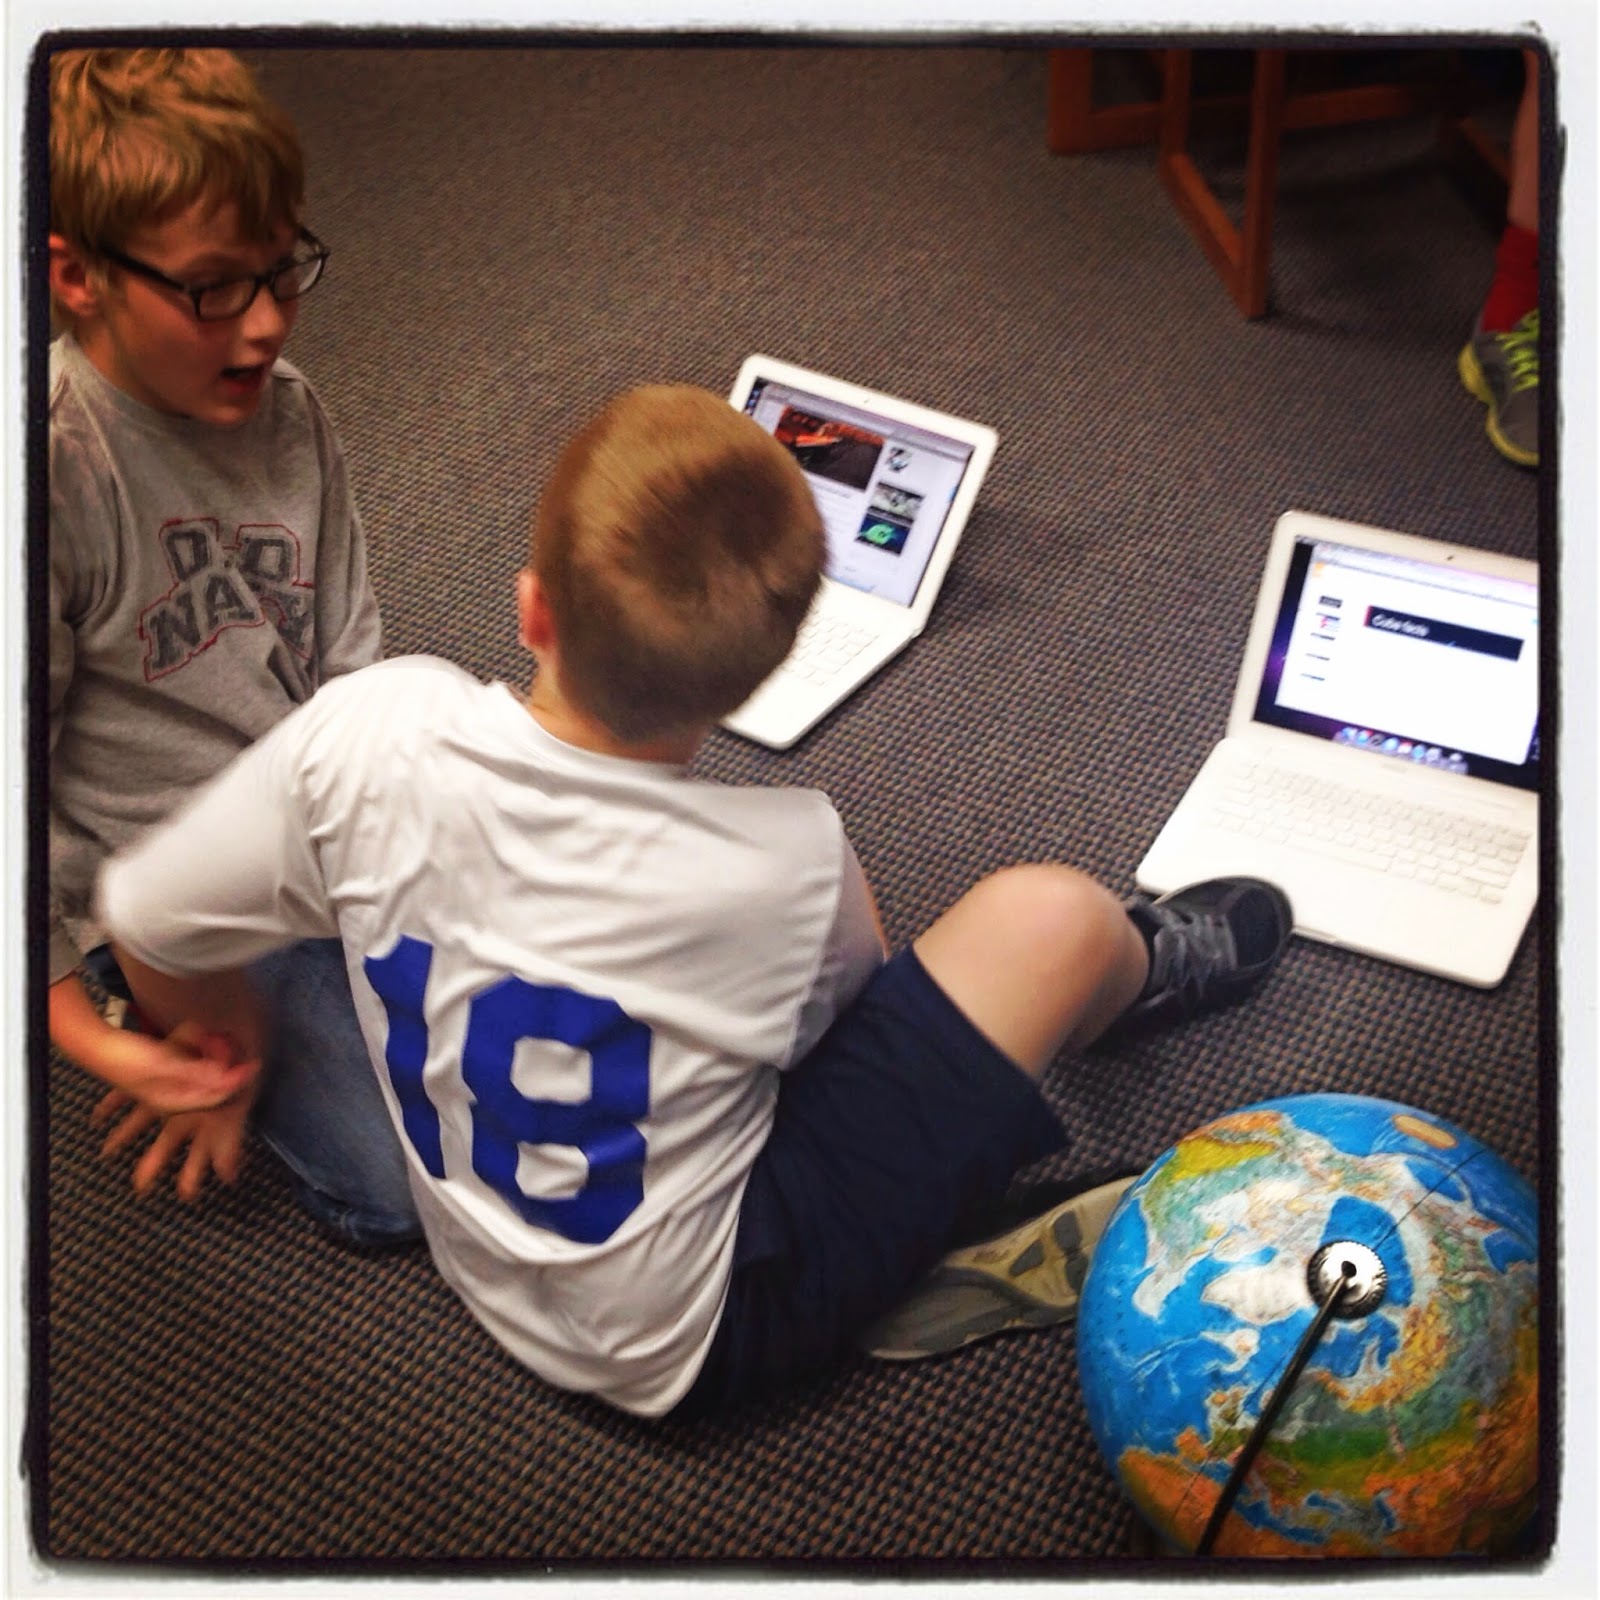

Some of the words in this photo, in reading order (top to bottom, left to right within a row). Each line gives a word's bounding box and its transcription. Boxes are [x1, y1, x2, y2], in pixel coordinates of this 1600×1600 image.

[164, 527, 294, 583] OD
[147, 574, 315, 668] NAY
[363, 934, 655, 1245] 18
